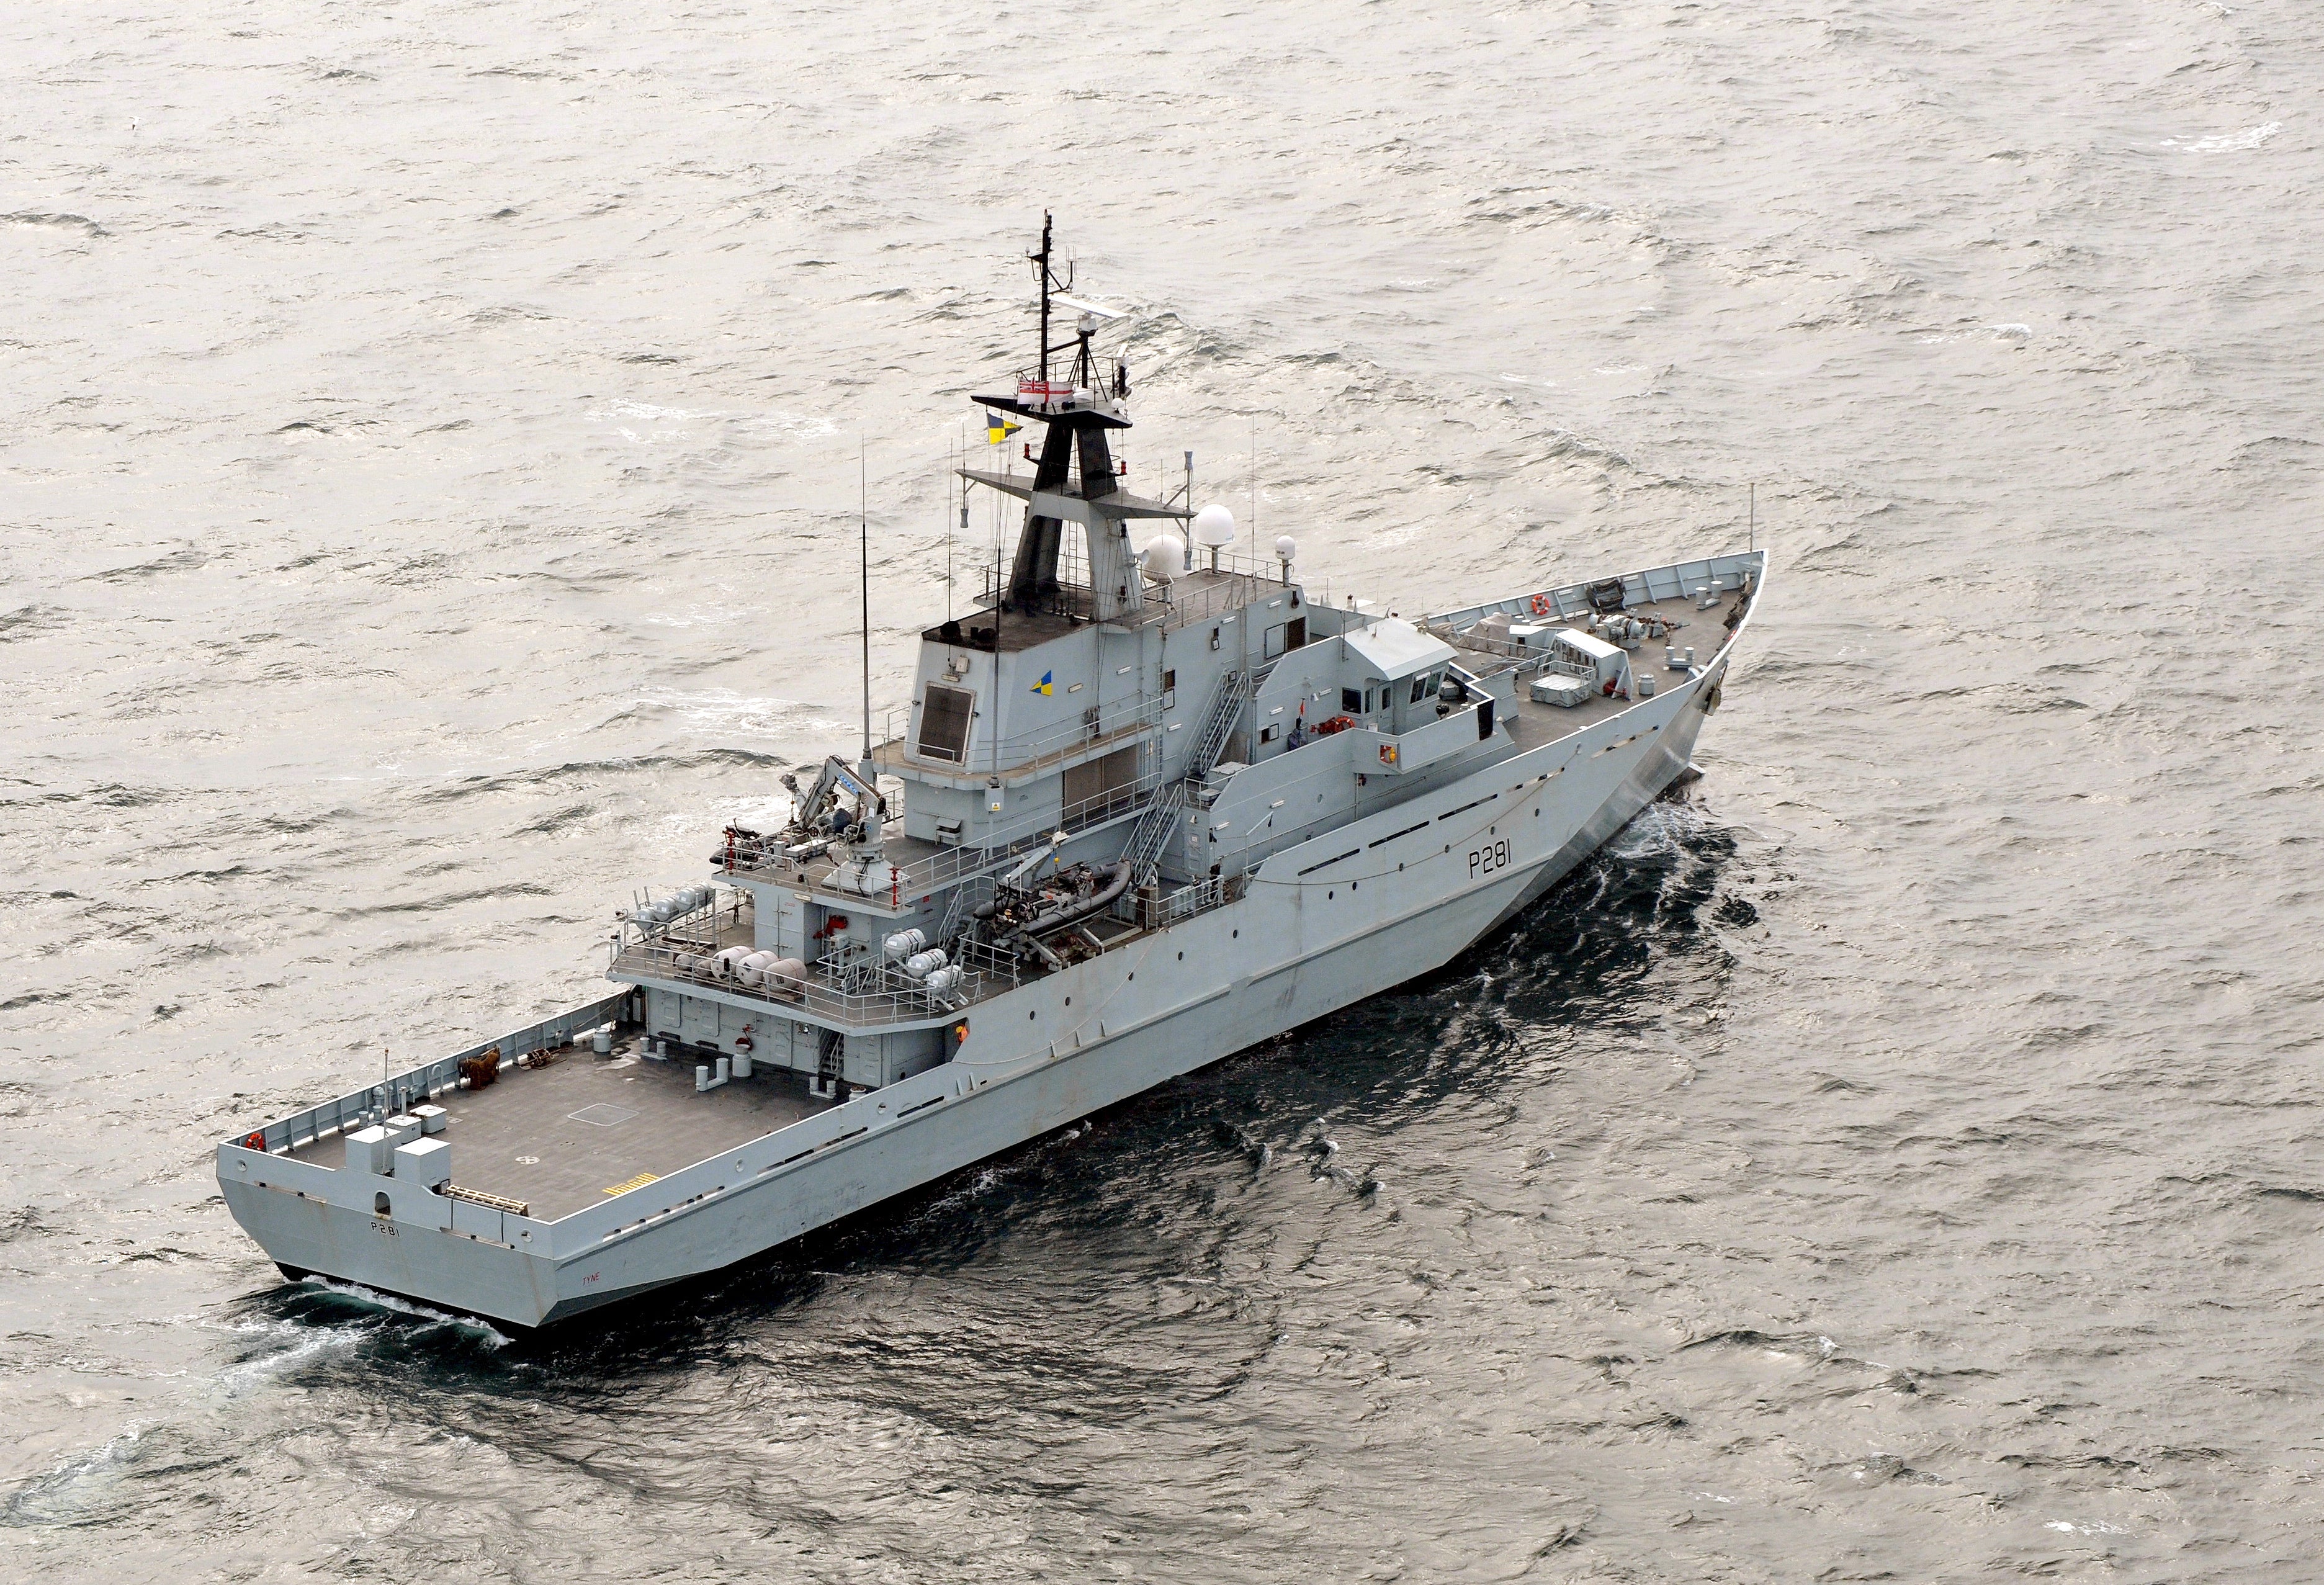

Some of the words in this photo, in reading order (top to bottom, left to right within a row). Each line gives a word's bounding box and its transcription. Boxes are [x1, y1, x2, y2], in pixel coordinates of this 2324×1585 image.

[1469, 838, 1511, 879] P281
[370, 1221, 400, 1237] P281
[582, 1271, 601, 1286] TYNE
